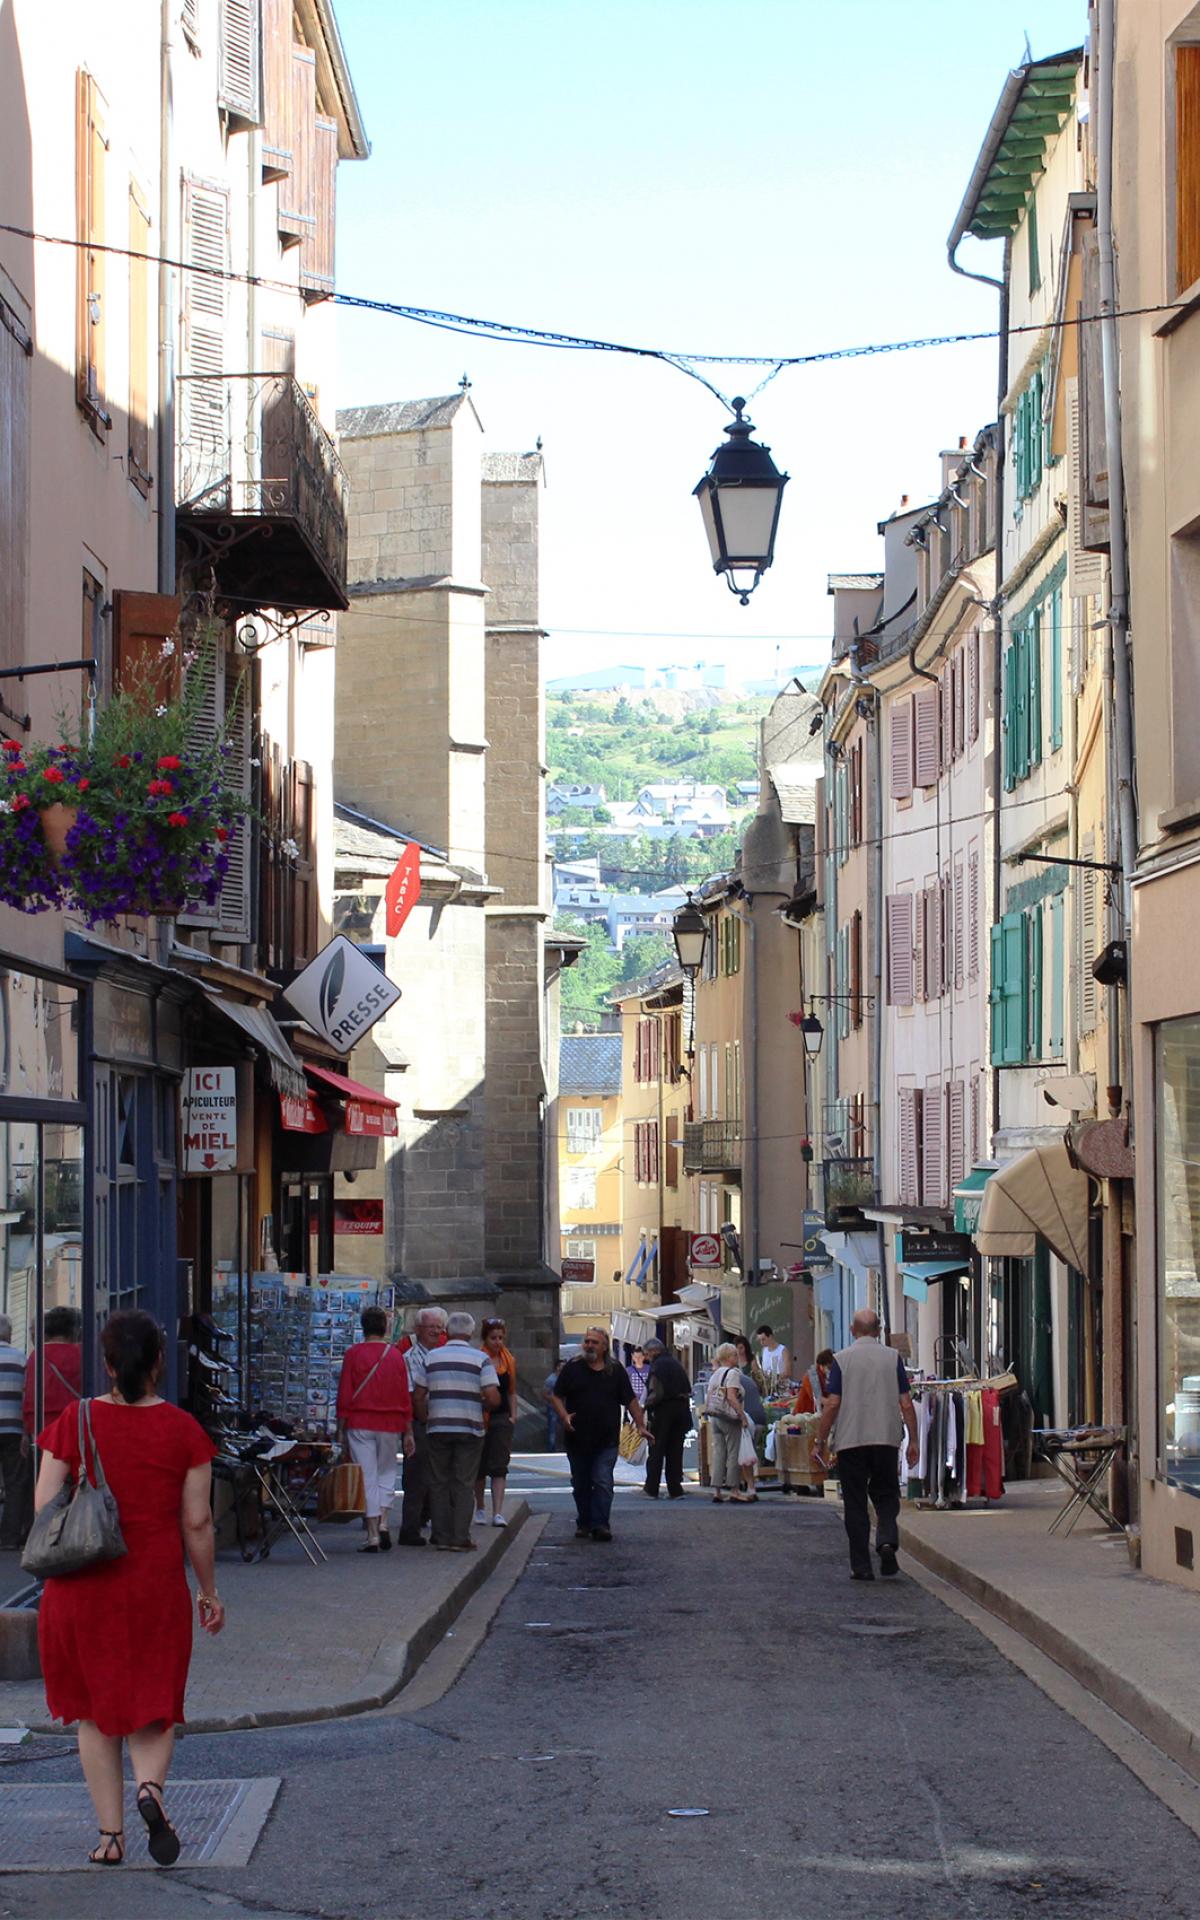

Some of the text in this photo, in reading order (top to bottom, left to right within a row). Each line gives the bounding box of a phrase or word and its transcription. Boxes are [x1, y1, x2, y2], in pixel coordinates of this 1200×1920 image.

[394, 867, 412, 914] TABAC
[331, 984, 389, 1044] PRESSE
[195, 1073, 221, 1091] ICI
[182, 1096, 236, 1108] APICULTEUR
[191, 1113, 227, 1121] VENTE
[184, 1132, 237, 1151] MIEL
